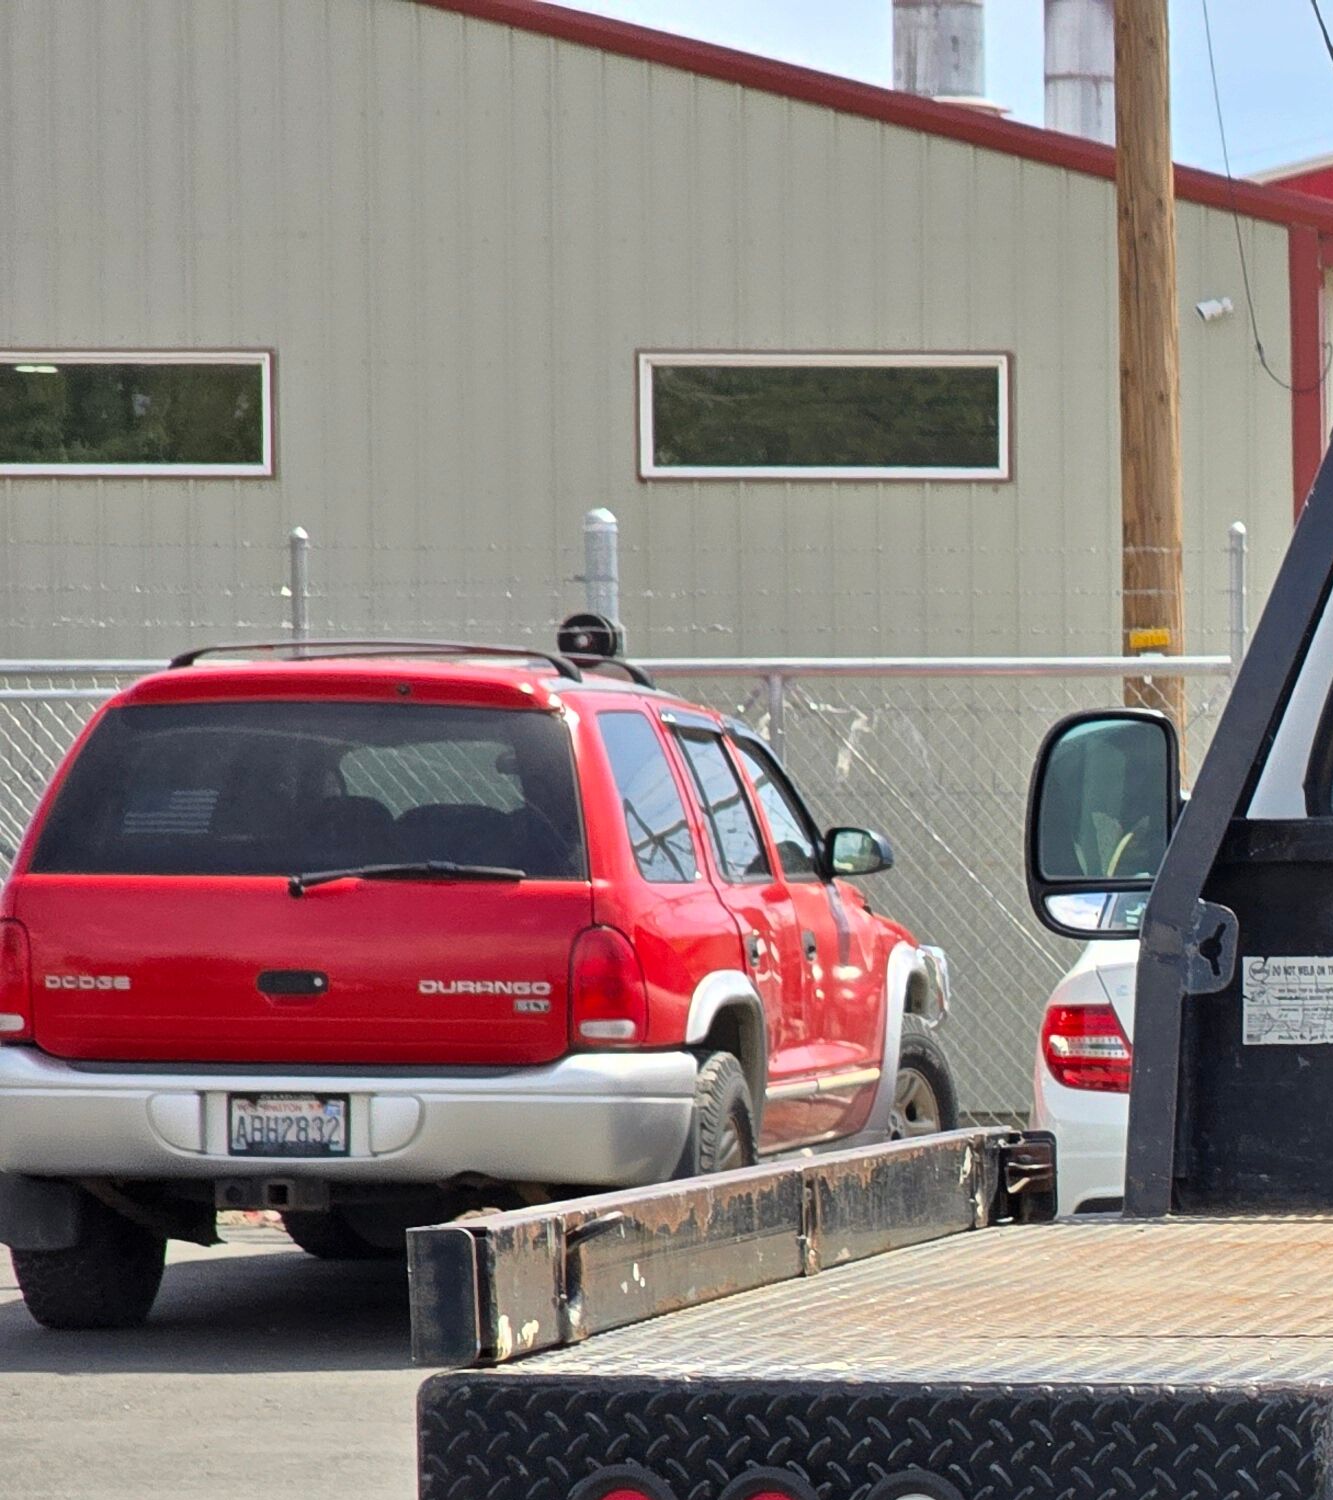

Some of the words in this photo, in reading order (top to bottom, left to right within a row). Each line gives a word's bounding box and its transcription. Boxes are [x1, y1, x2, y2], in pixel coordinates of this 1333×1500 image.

[1272, 965, 1281, 976] DO
[1283, 965, 1296, 976] NOT
[1298, 965, 1314, 976] WELD
[1316, 965, 1326, 976] ON
[45, 975, 131, 990] DODGE
[418, 979, 552, 996] DURANGO
